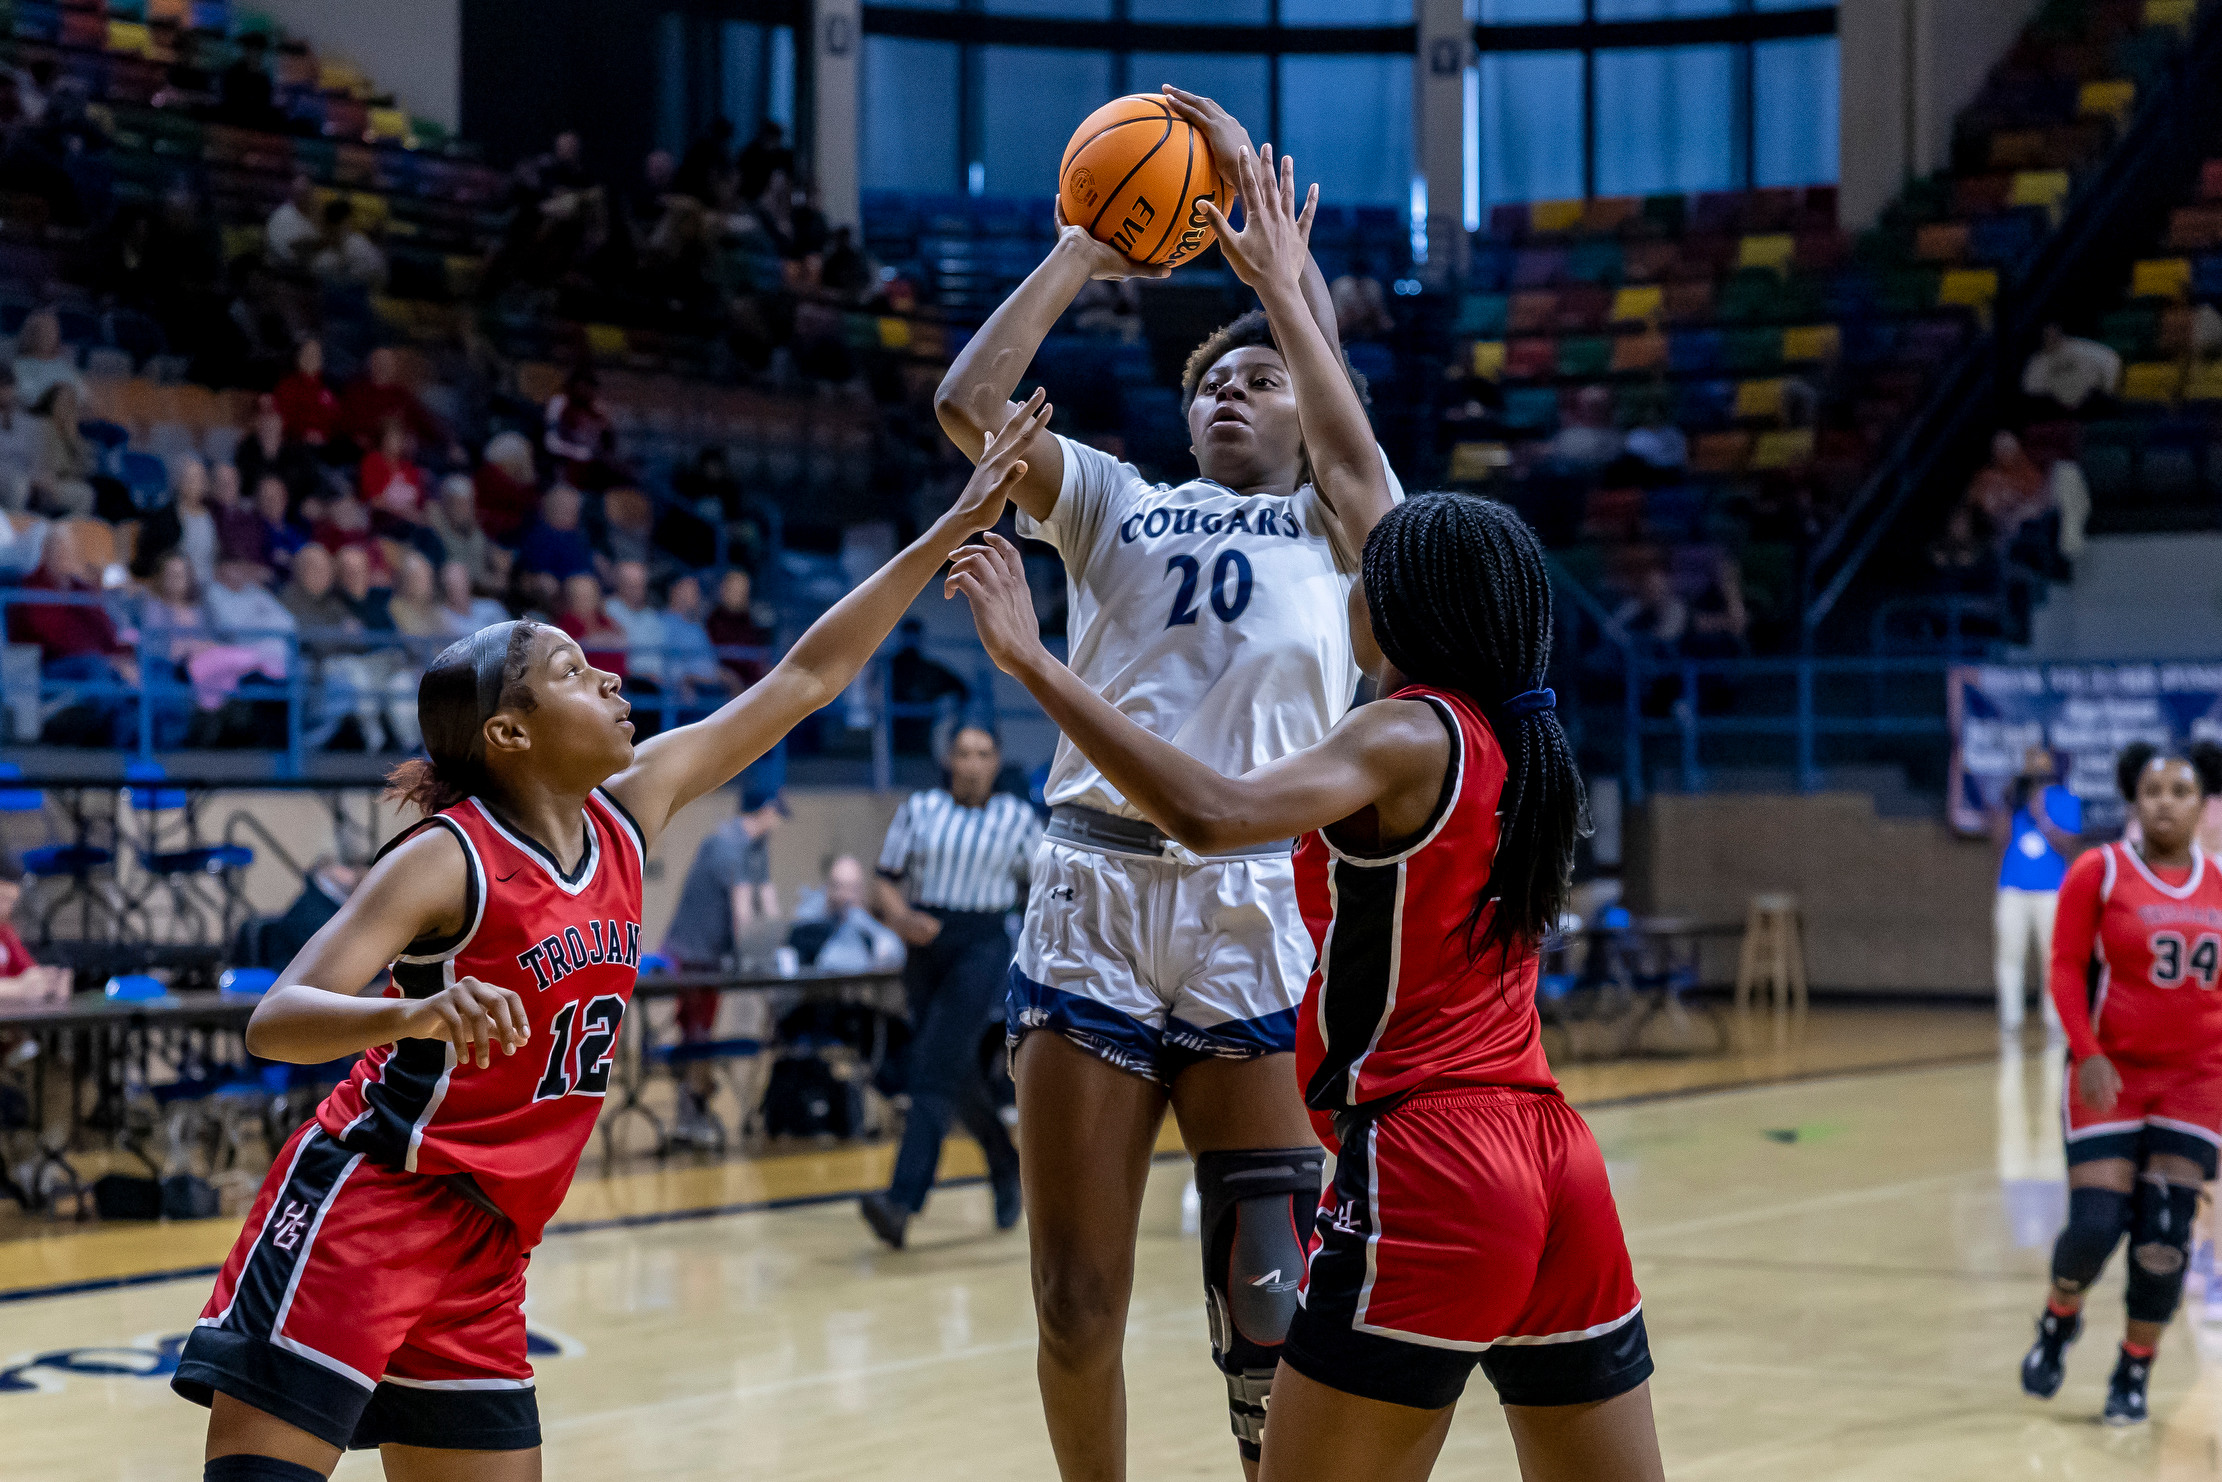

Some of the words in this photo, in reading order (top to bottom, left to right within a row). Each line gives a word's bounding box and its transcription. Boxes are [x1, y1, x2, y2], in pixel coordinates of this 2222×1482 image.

[1157, 190, 1216, 267] Wils
[1121, 507, 1300, 544] COUGARS
[1162, 548, 1254, 631] 20
[517, 919, 643, 992] TROJAN
[2147, 931, 2221, 989] 34
[532, 993, 627, 1103] 12
[273, 1200, 309, 1251] HG
